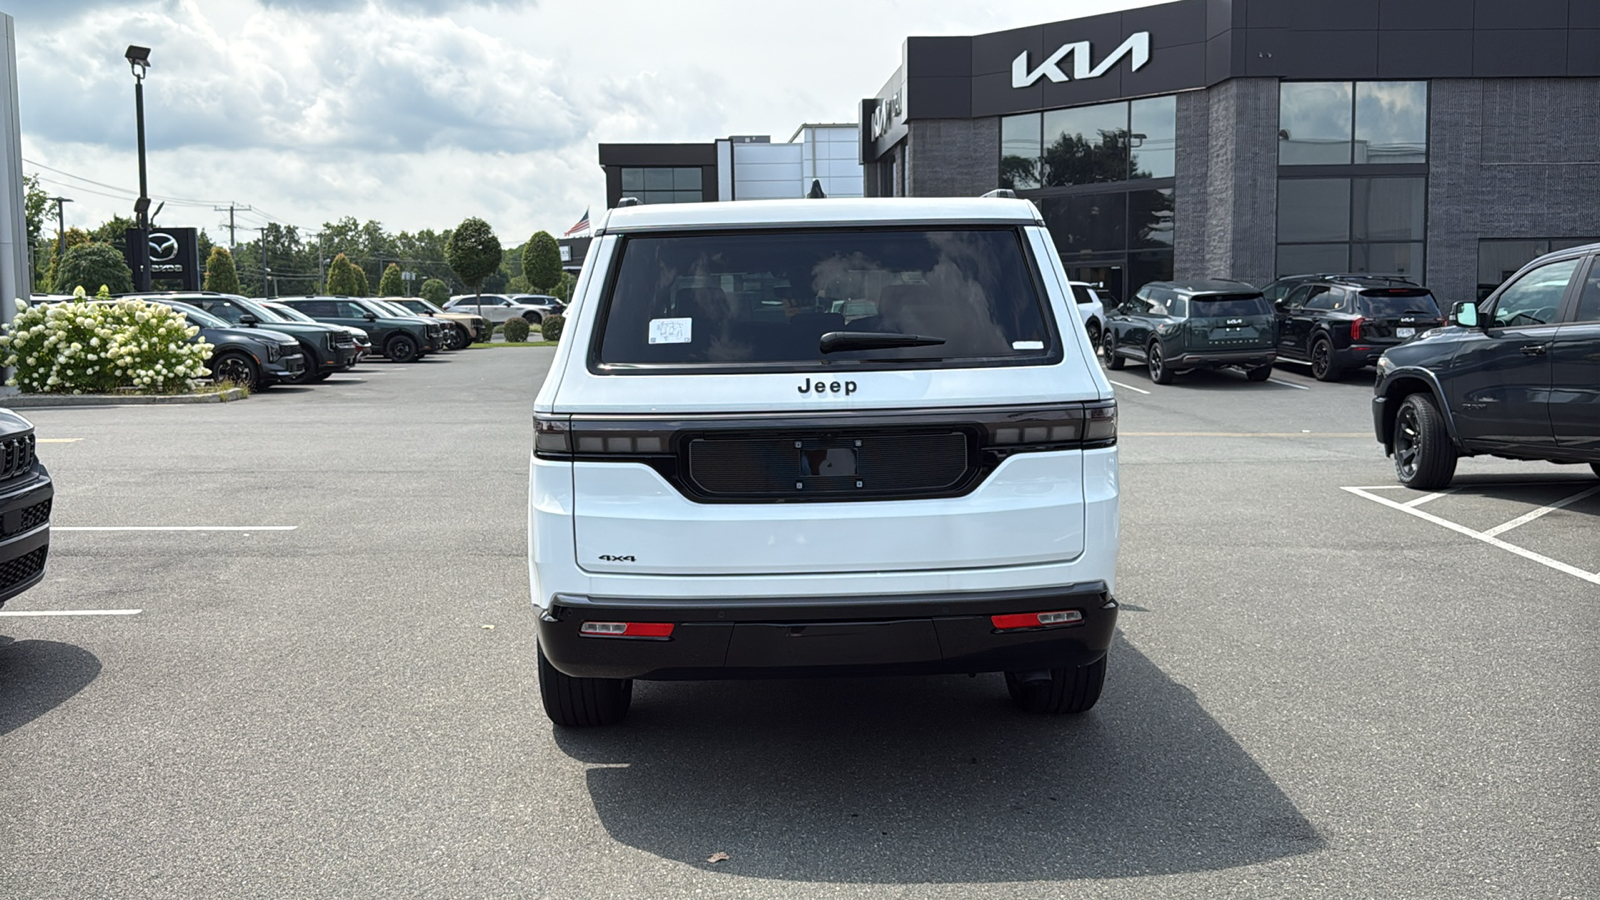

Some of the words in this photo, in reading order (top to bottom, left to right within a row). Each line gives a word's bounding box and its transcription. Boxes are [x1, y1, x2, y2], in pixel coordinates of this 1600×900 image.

[1012, 31, 1149, 88] KIA
[140, 264, 183, 272] azda
[797, 377, 857, 396] Jeep
